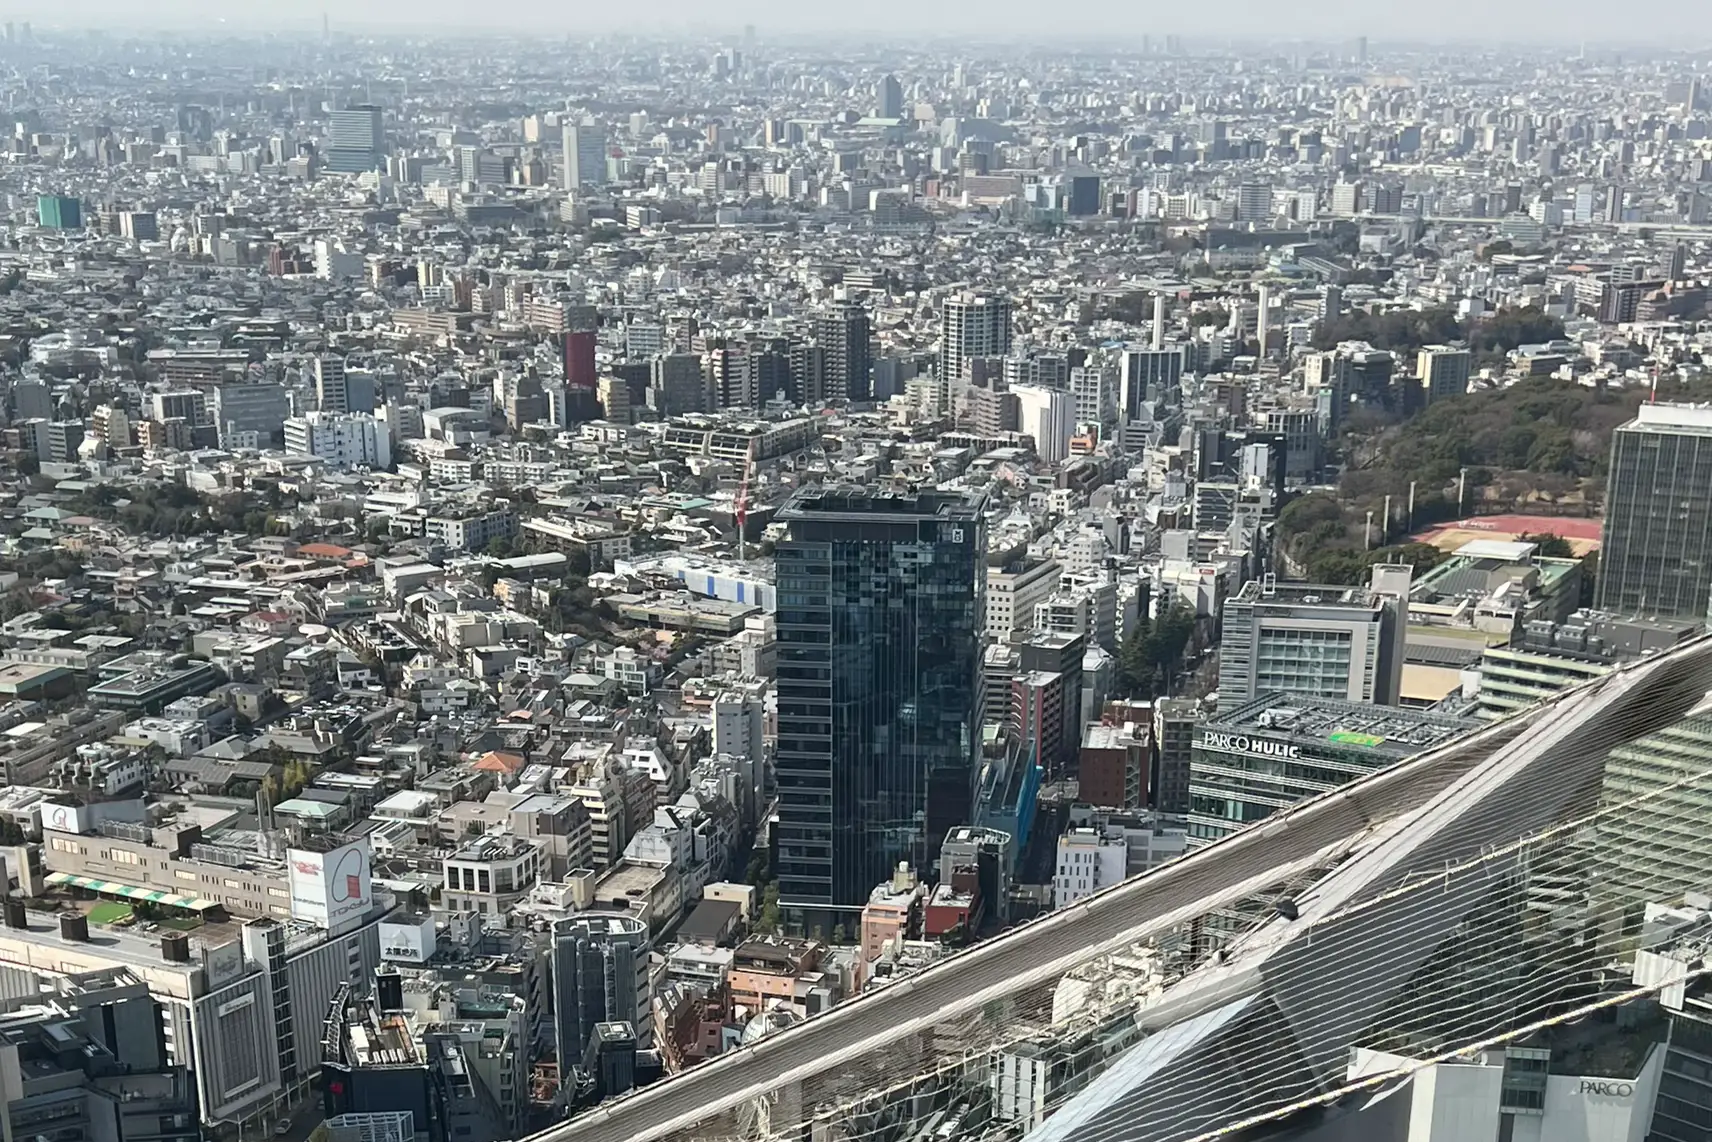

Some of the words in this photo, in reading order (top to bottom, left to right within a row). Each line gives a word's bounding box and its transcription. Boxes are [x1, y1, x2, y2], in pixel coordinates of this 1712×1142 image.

[1204, 731, 1250, 752] PARCO
[1251, 740, 1299, 758] HULIC
[1580, 1081, 1632, 1097] PARCO
